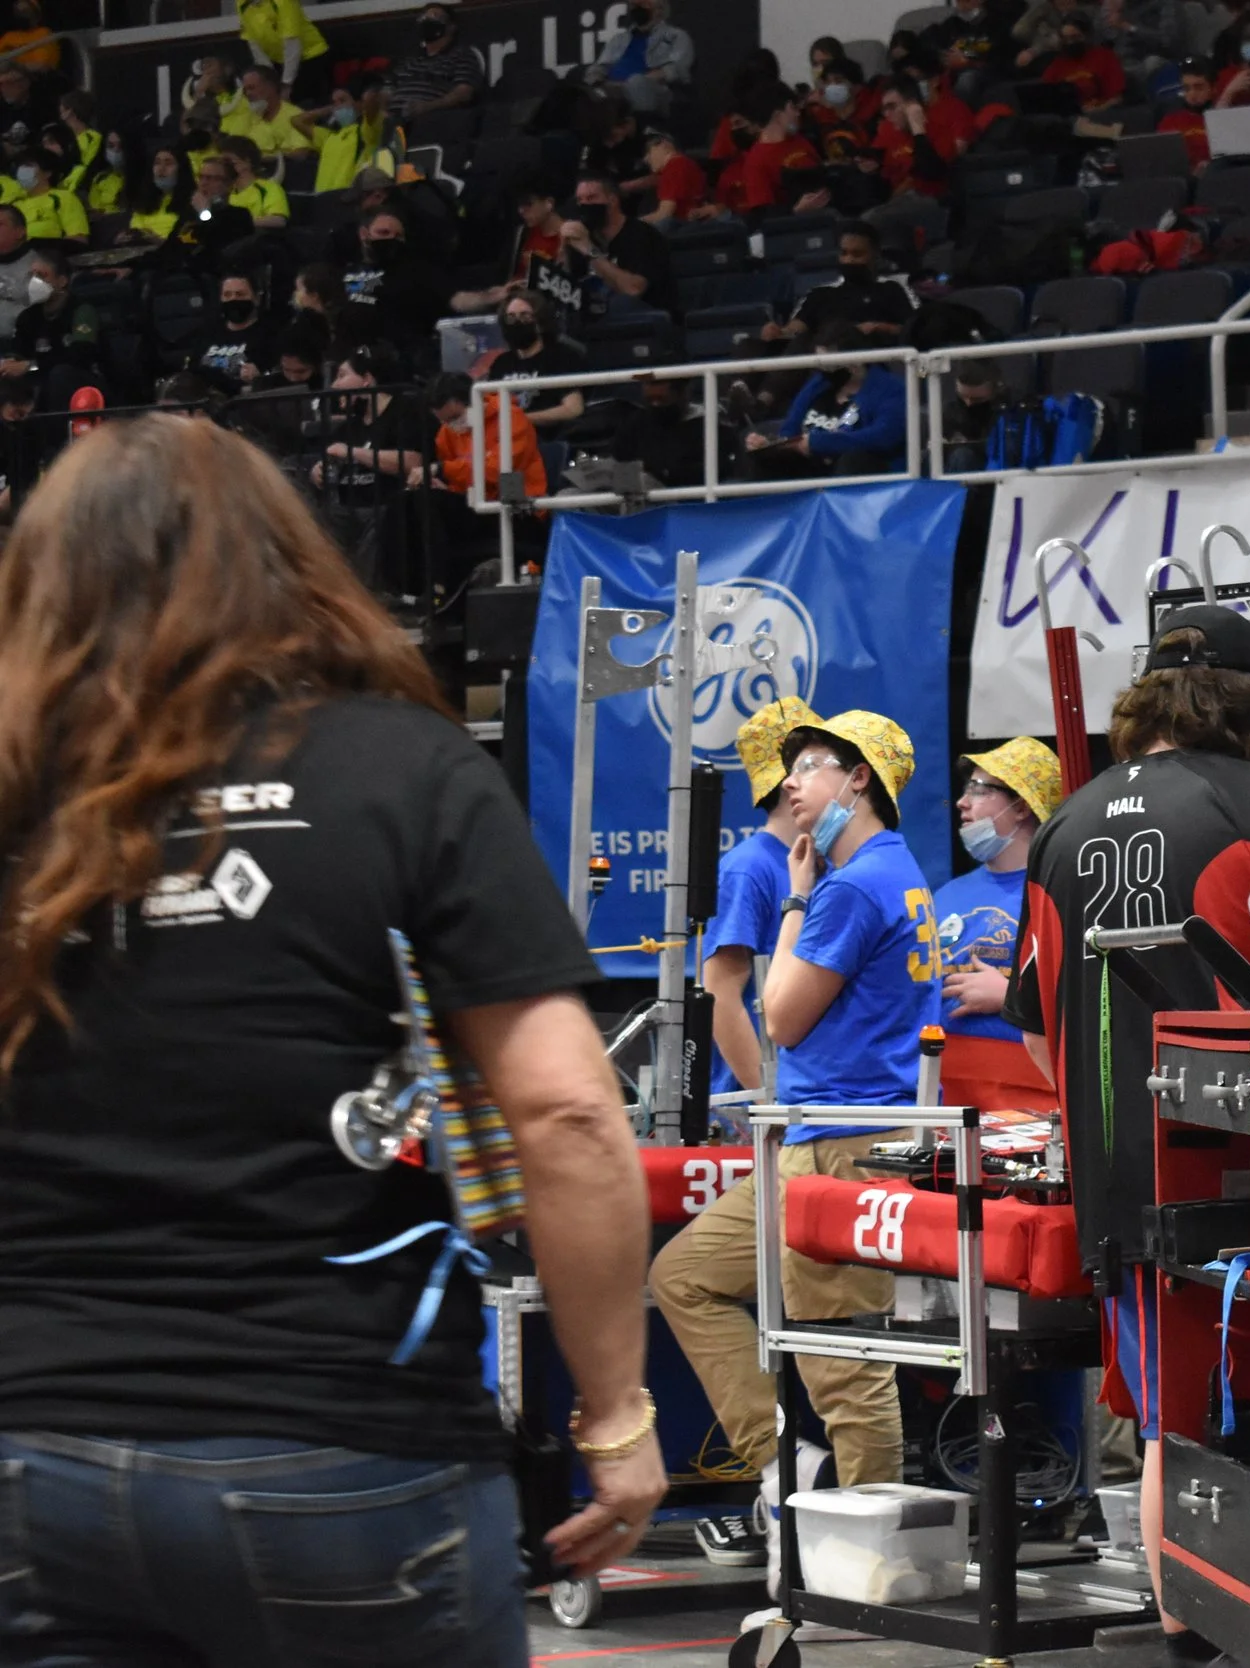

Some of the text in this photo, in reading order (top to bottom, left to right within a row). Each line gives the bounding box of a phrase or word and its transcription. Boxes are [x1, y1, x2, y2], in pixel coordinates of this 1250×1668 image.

[541, 3, 629, 72] Lif
[537, 263, 583, 310] 5484
[1106, 796, 1146, 819] HALL
[609, 831, 632, 855] IS
[629, 869, 668, 893] FIR
[1078, 828, 1168, 960] 28
[683, 1039, 698, 1099] Clippard
[854, 1188, 914, 1262] 28
